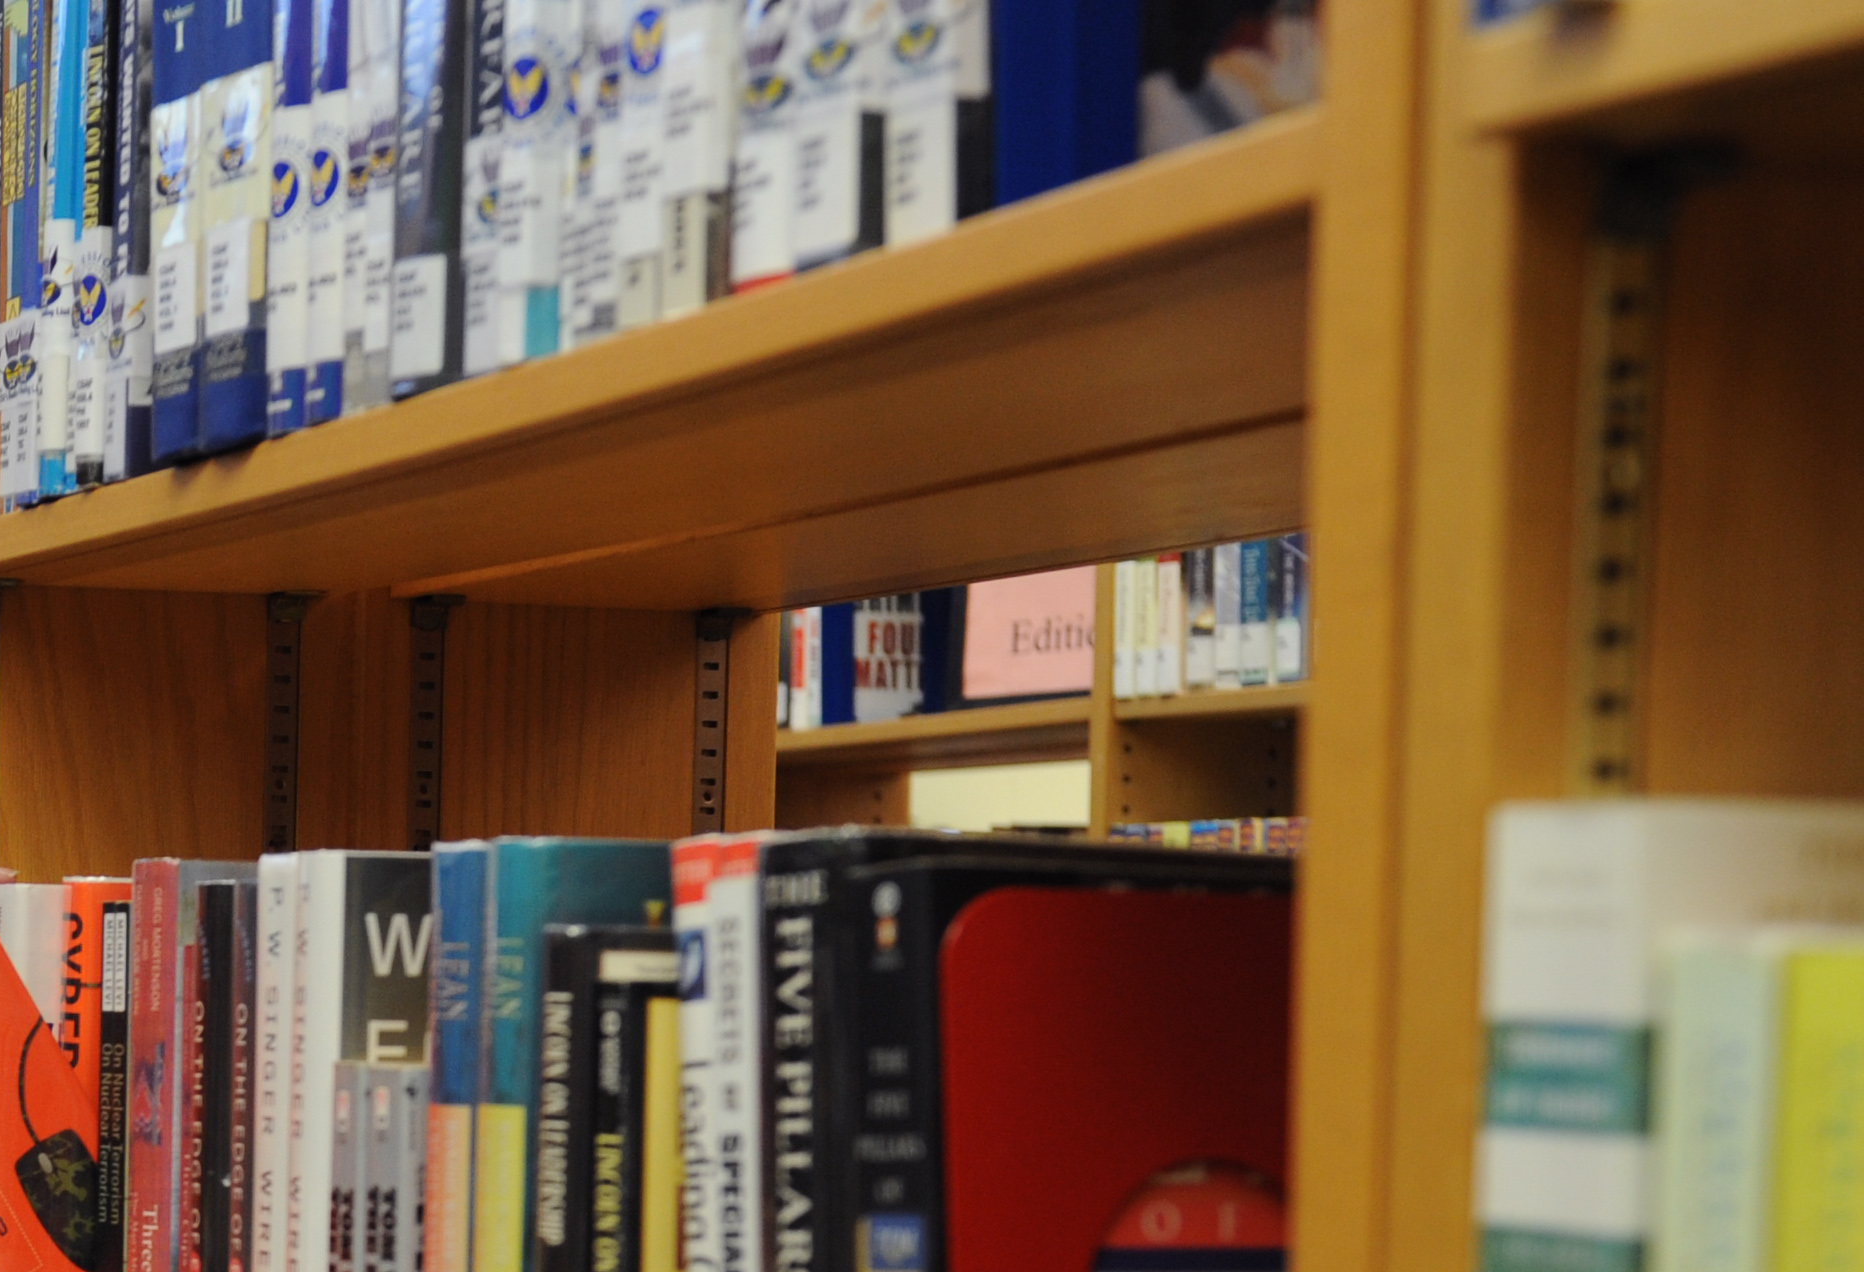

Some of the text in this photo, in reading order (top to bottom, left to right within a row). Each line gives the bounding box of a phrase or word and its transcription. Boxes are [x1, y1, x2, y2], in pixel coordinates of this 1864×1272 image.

[28, 68, 39, 188] HORIZONS
[82, 43, 104, 230] LINCOLN ON LEADER
[120, 55, 134, 186] WANTED
[118, 191, 131, 236] TO
[150, 887, 162, 1013] GREG MORTENSON
[438, 941, 470, 1020] LEAN
[494, 937, 524, 1019] LEAN
[774, 914, 815, 1050] FIVE
[193, 1000, 205, 1043] ON
[235, 1002, 248, 1047] ON
[262, 987, 277, 1136] SINGER
[192, 1054, 204, 1109] THE
[234, 1057, 247, 1113] THE
[541, 1082, 570, 1116] ON
[98, 1042, 113, 1223] On Nuclear Terrorism
[111, 1043, 124, 1225] On Nuclear Terrorism
[232, 1124, 245, 1202] EDGE
[595, 1132, 623, 1230] LINCOLN
[230, 1211, 243, 1251] OF
[594, 1236, 620, 1272] ON
